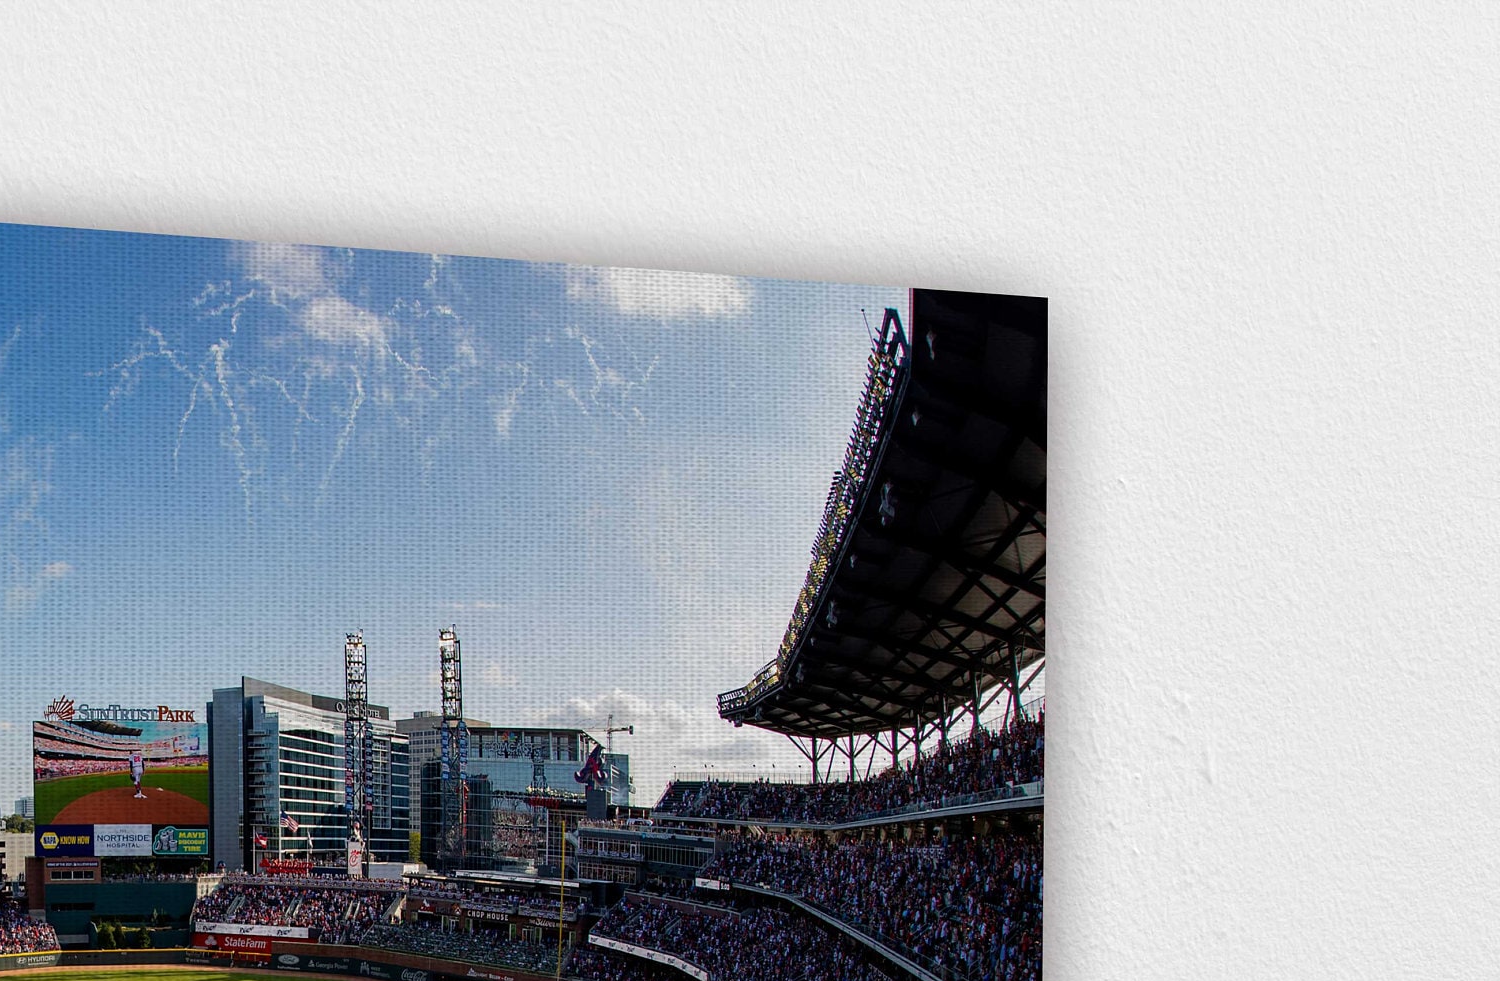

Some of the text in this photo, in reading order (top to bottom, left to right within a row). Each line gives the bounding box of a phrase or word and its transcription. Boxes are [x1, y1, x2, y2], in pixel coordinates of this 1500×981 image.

[96, 834, 150, 842] NORTHSIDE
[467, 909, 509, 922] CHOP HOUSE
